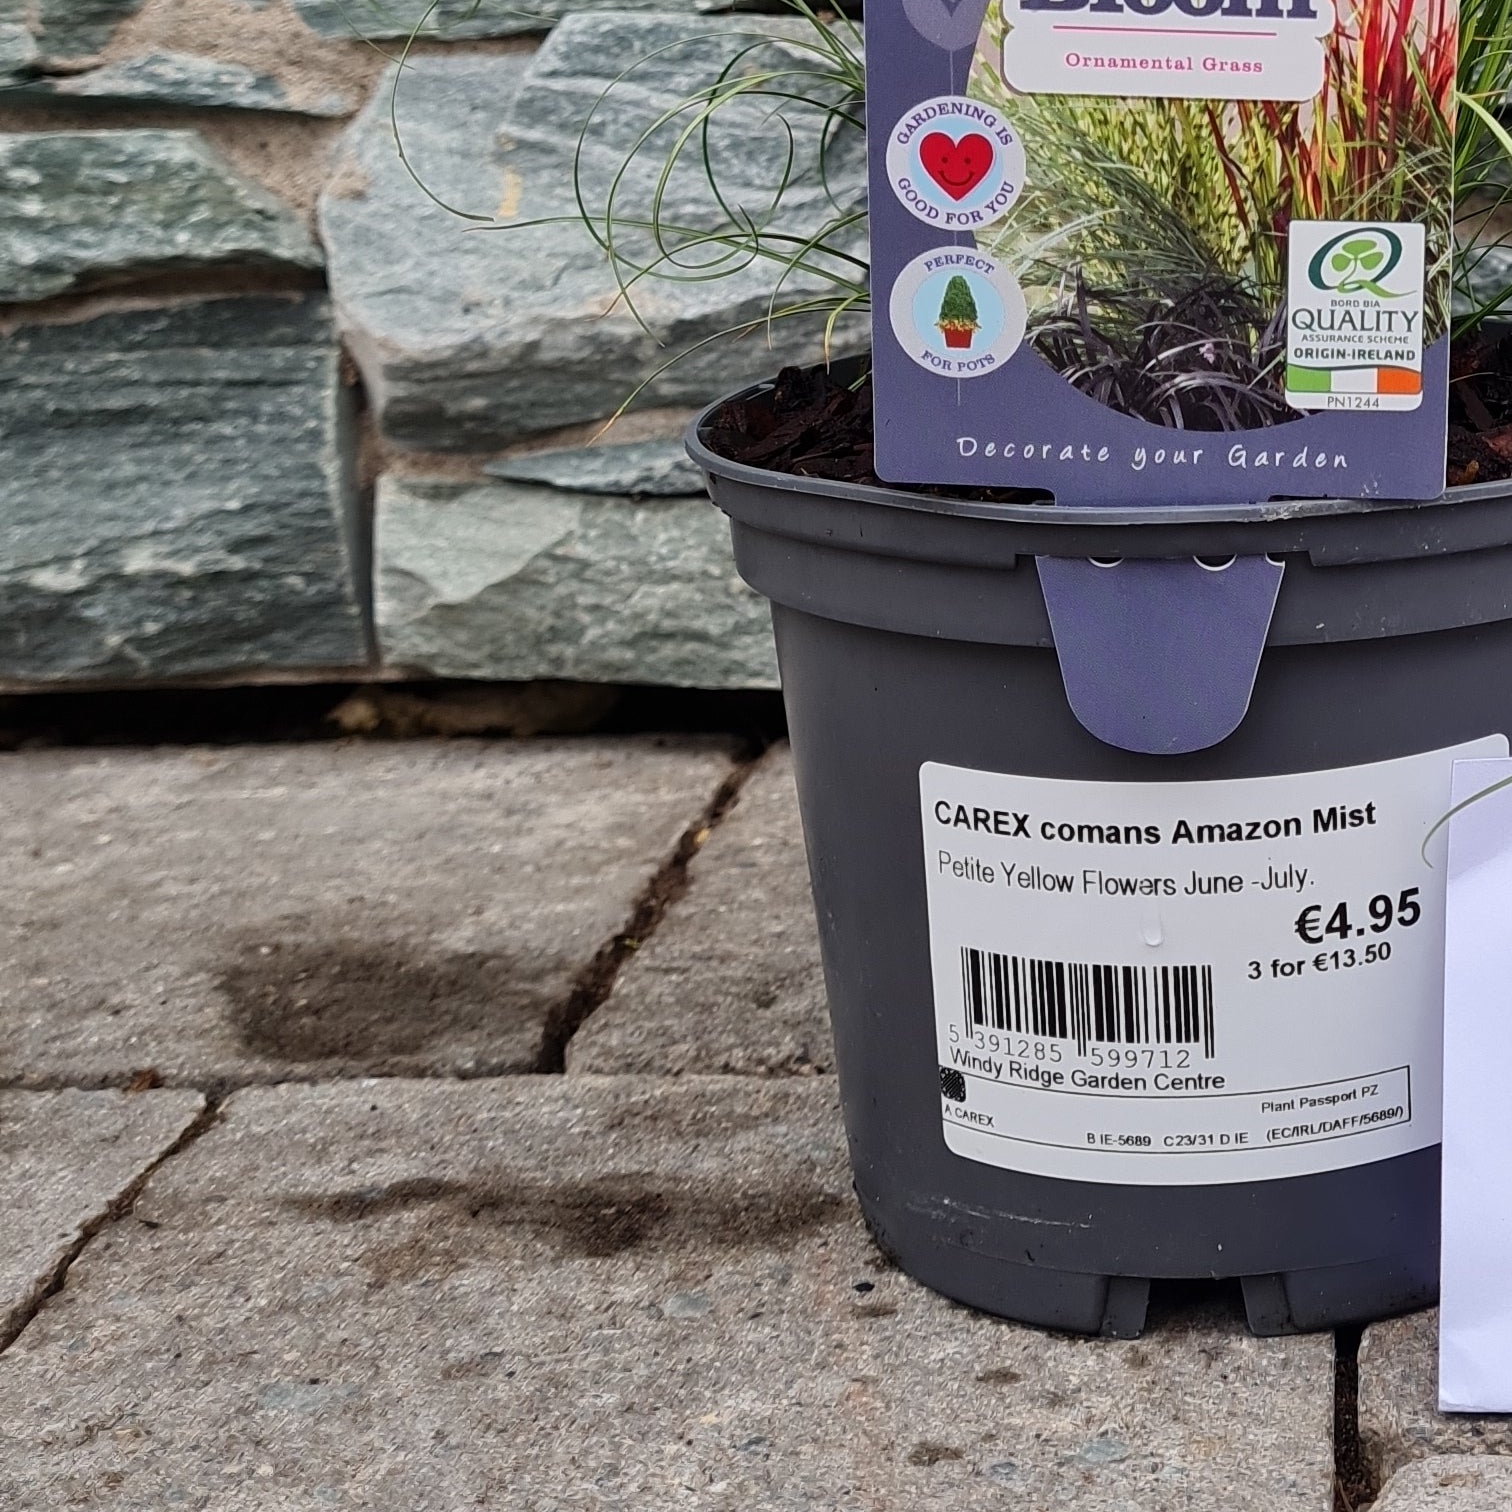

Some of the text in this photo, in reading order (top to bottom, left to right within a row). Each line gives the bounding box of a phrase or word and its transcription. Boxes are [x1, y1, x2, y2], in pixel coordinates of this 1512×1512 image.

[1065, 52, 1263, 73] Ornamental Grass
[897, 102, 1013, 146] GARDENING IS
[898, 178, 1014, 225] GOOD FOR YOU
[924, 254, 994, 274] PERFECT
[1363, 300, 1380, 308] BIA
[1292, 308, 1419, 332] QUALITY
[1301, 334, 1409, 344] ASSURANCE SCHEME
[921, 350, 995, 372] FOR POTS
[1294, 348, 1415, 361] ORIGIN-IRELAND
[1327, 396, 1379, 408] PN1244
[957, 437, 1348, 471] Decorate your Garden
[934, 800, 1377, 844] CAREX comans Amazon Mist
[938, 850, 1314, 895] Petite Yellow Flowers June -July.
[1294, 887, 1421, 944] €4.95
[1248, 942, 1391, 979] 3 for €13.50
[950, 1024, 1191, 1069] 5 391285 599712
[950, 1046, 1226, 1090] Windy Ridge Garden Centre
[1262, 1085, 1379, 1114] Plant Passport PZ
[955, 1108, 994, 1128] CAREX
[1088, 1133, 1096, 1144] B
[1100, 1134, 1152, 1146] IE-5689
[1220, 1133, 1231, 1145] D
[1235, 1132, 1248, 1144] IE
